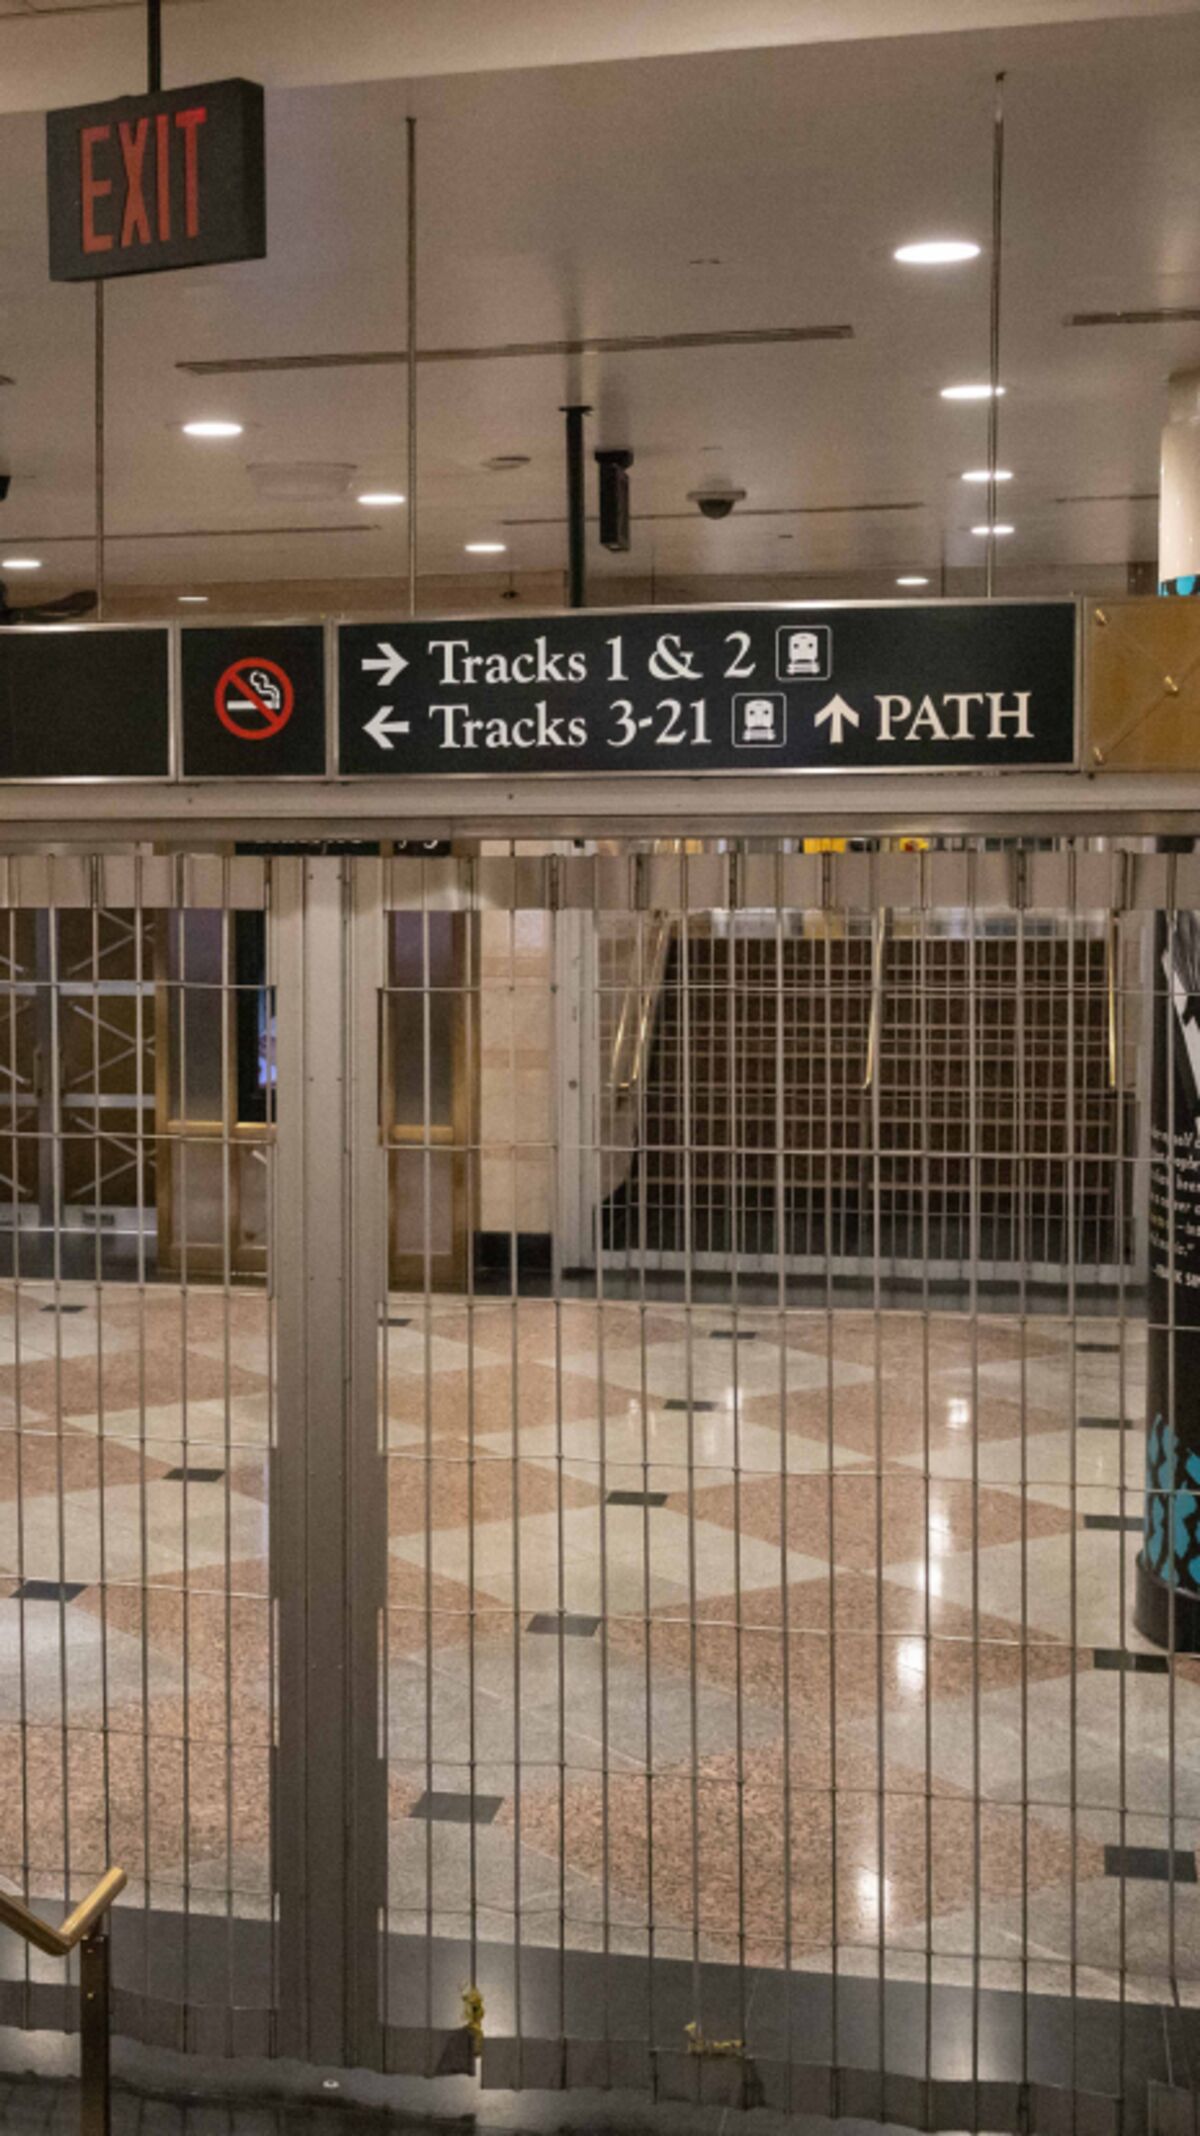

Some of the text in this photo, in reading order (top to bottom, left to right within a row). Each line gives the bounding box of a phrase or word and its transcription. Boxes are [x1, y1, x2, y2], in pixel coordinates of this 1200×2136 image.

[82, 106, 207, 254] EXIT
[428, 630, 757, 686] Tracks 1 & 2
[428, 698, 713, 749] Tracks 3-21
[874, 691, 1034, 741] PATH
